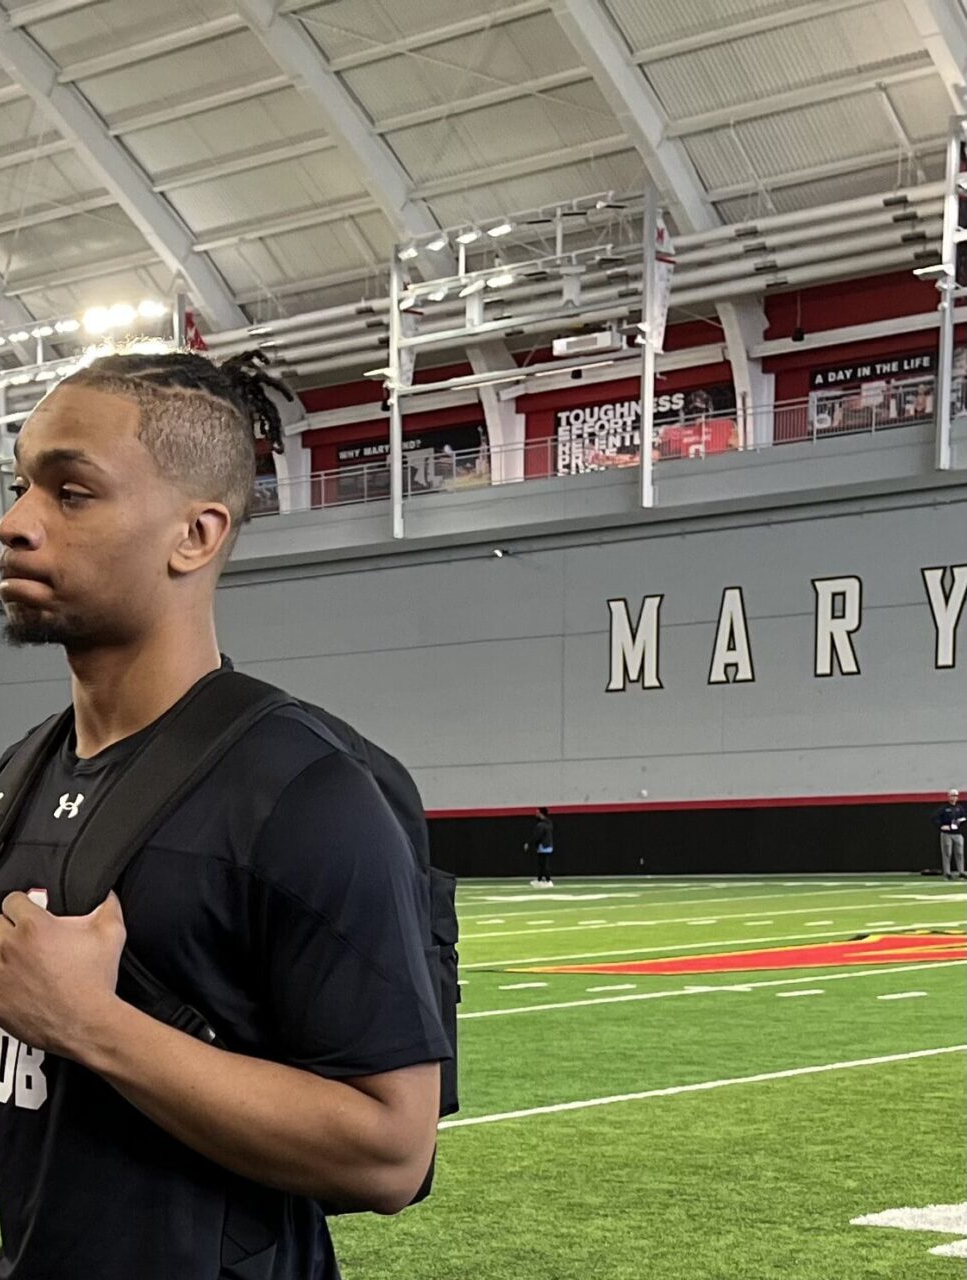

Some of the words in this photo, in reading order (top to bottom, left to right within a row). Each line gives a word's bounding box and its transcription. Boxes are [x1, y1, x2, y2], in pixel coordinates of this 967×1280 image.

[815, 374, 824, 385] A
[828, 368, 853, 383] DAY
[857, 366, 871, 378] IN
[875, 361, 899, 375] THE
[903, 356, 931, 371] LIFE
[558, 415, 636, 442] EFFORT
[338, 449, 361, 460] WHY
[363, 439, 422, 457] MARYND?
